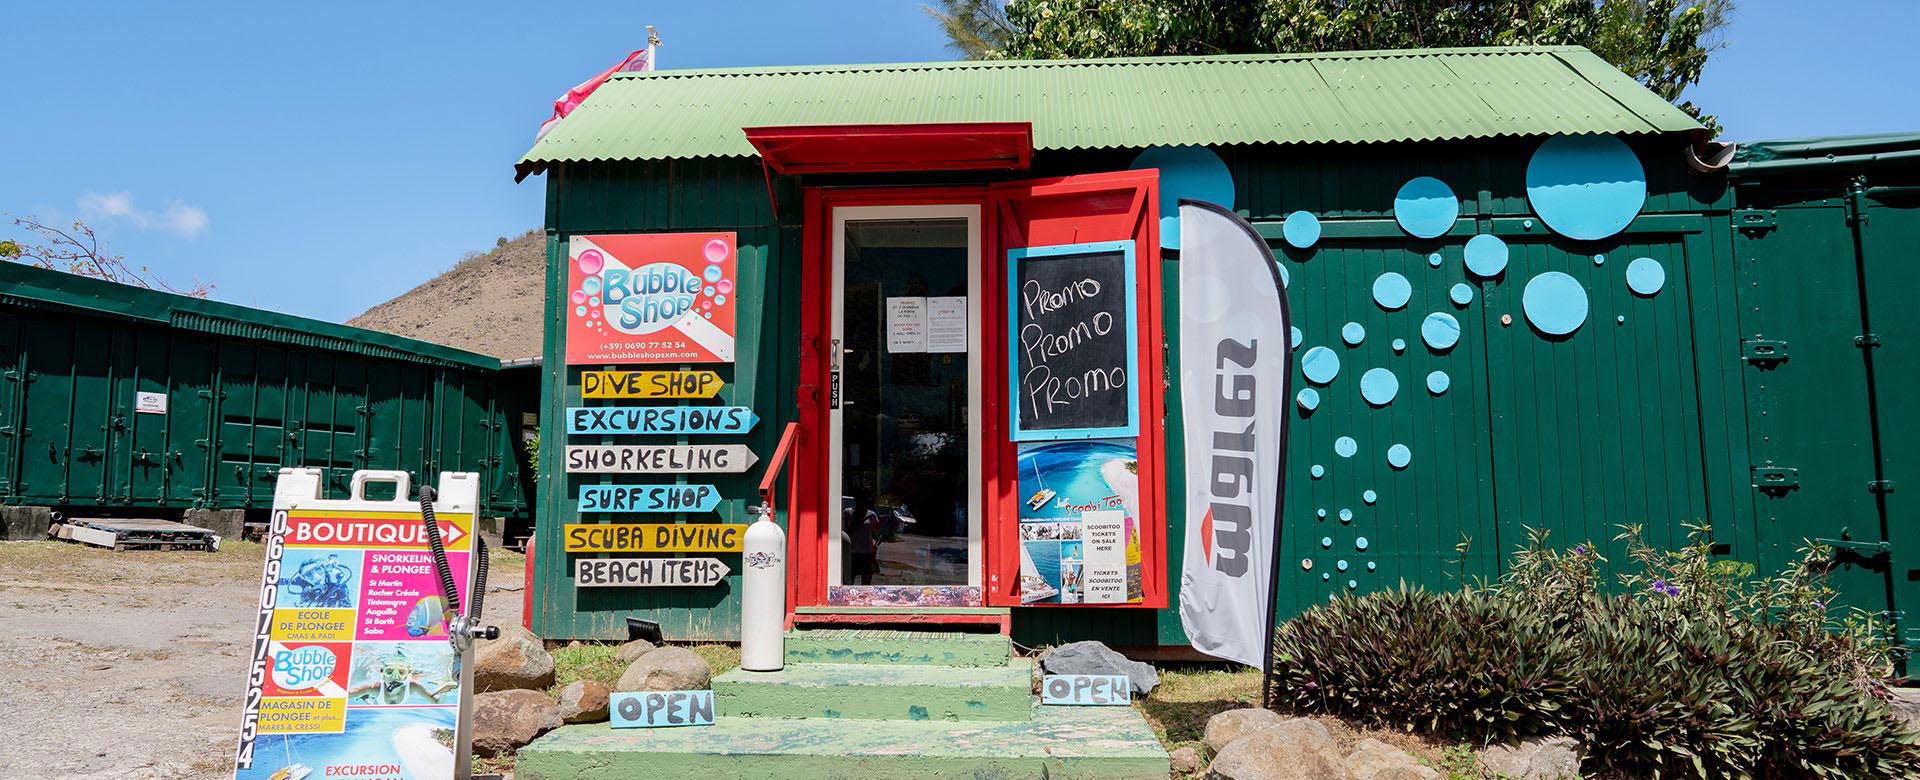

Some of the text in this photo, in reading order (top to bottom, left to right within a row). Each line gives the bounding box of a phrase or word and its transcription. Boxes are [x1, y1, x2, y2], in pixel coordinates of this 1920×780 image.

[603, 266, 702, 305] Bubble
[620, 295, 693, 329] Shop
[662, 341, 673, 349] 52
[675, 341, 686, 349] 54
[587, 351, 698, 360] www.bubbleshopsxm.com
[650, 372, 714, 396] SHOP
[582, 486, 710, 511] SURF SHOP
[296, 522, 430, 543] BOUTIQUE
[569, 527, 643, 549] SCUBA
[370, 565, 431, 574] & PLONGEE
[580, 560, 653, 584] BEACH
[378, 579, 403, 587] Martin
[298, 611, 330, 620] ECOLE
[366, 608, 397, 616] Anguilla
[280, 622, 345, 631] DE PLONGEE
[374, 617, 395, 625] Barth
[274, 649, 337, 671] Bubble
[1049, 676, 1127, 703] OPEN
[261, 701, 331, 710] MAGASIN DE
[618, 692, 713, 725] OPEN
[260, 712, 311, 721] PLONGEE
[325, 764, 401, 777] EXCURSION
